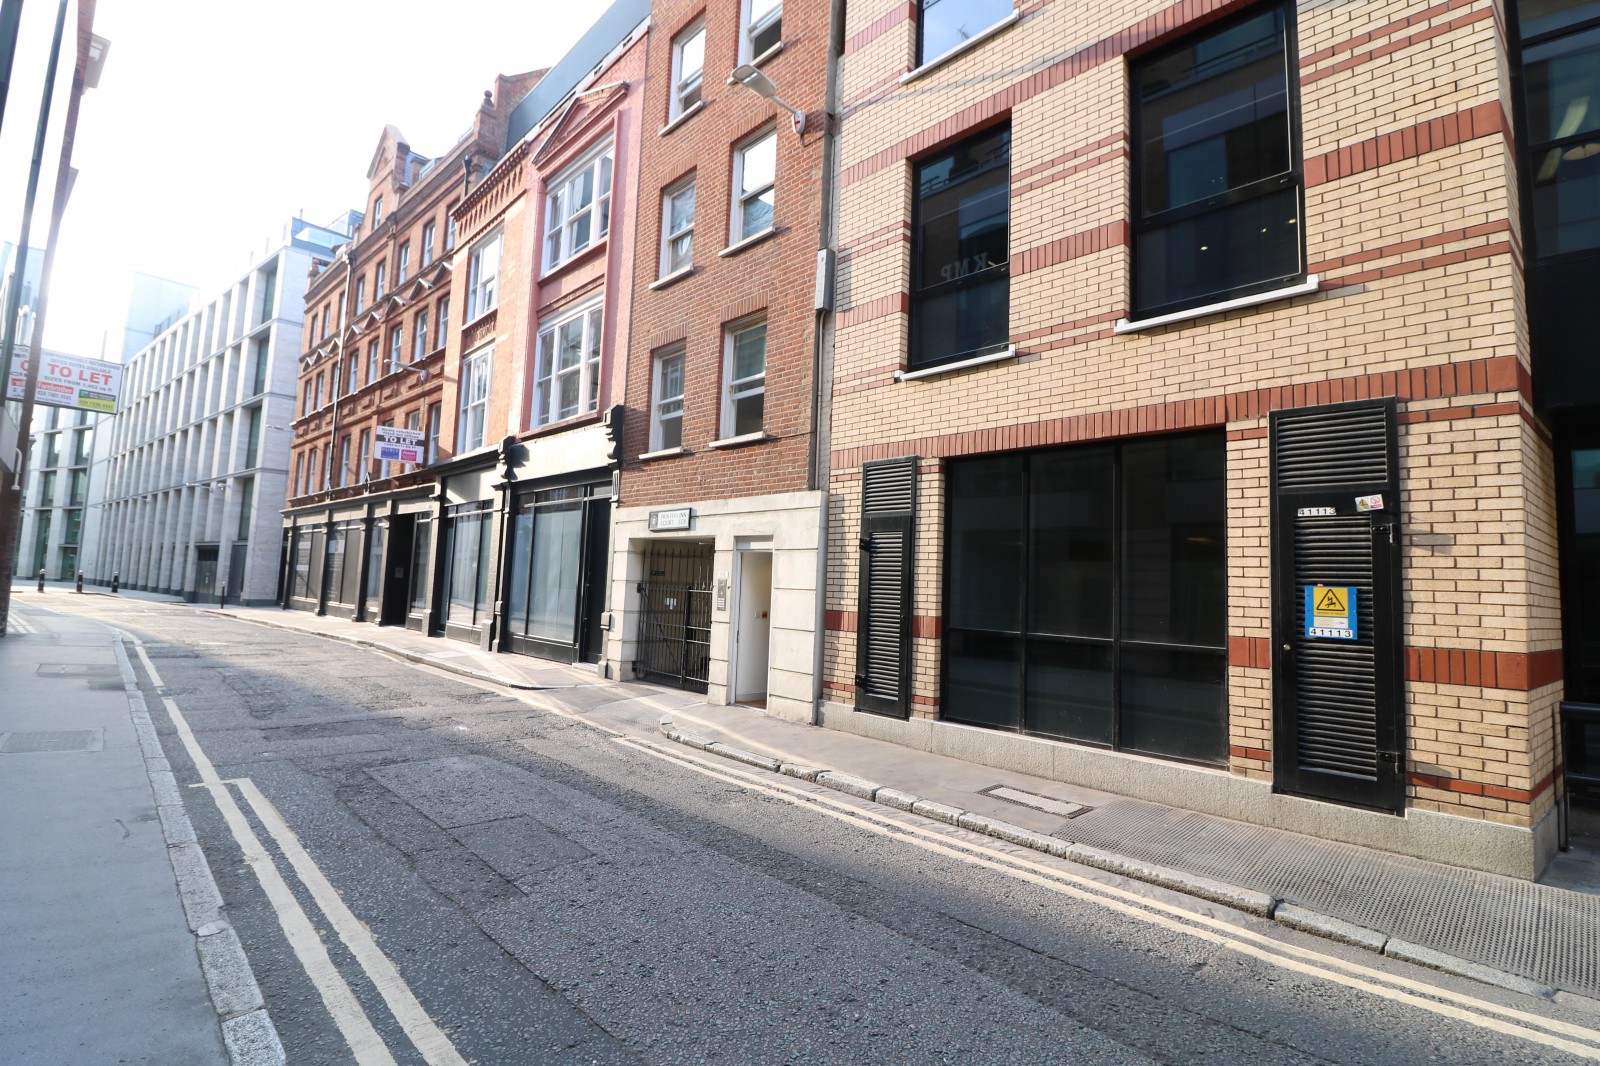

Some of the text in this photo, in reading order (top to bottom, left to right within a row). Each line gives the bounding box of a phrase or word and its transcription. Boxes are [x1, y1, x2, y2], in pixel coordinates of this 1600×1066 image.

[47, 363, 113, 386] TO LET
[63, 379, 81, 387] FROM
[384, 435, 418, 445] TO LET
[1299, 507, 1336, 515] 41113
[1310, 628, 1351, 637] 41113
